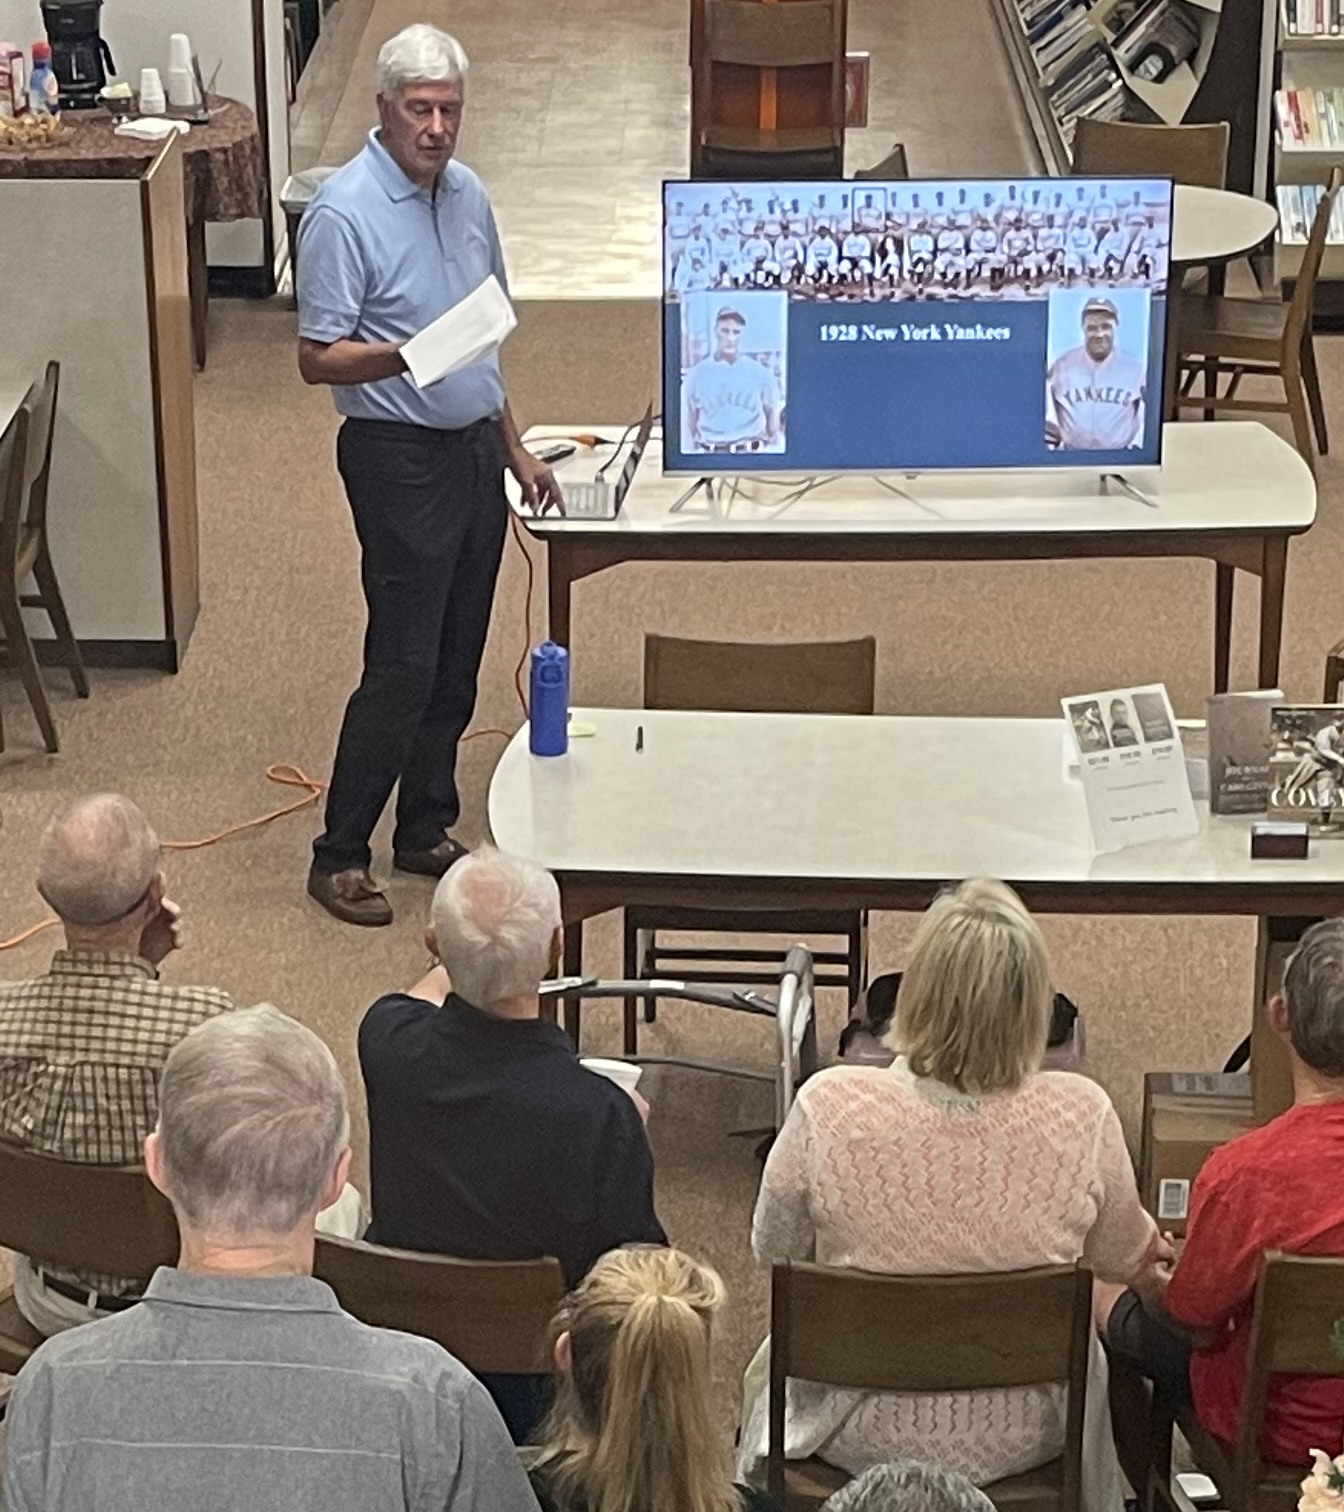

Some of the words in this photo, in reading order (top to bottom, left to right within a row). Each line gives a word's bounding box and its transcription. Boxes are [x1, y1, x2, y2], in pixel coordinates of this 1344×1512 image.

[819, 324, 858, 341] 1928
[861, 324, 898, 341] New
[900, 324, 942, 341] York
[944, 323, 1011, 341] Yankees
[1062, 386, 1133, 407] YANKEES
